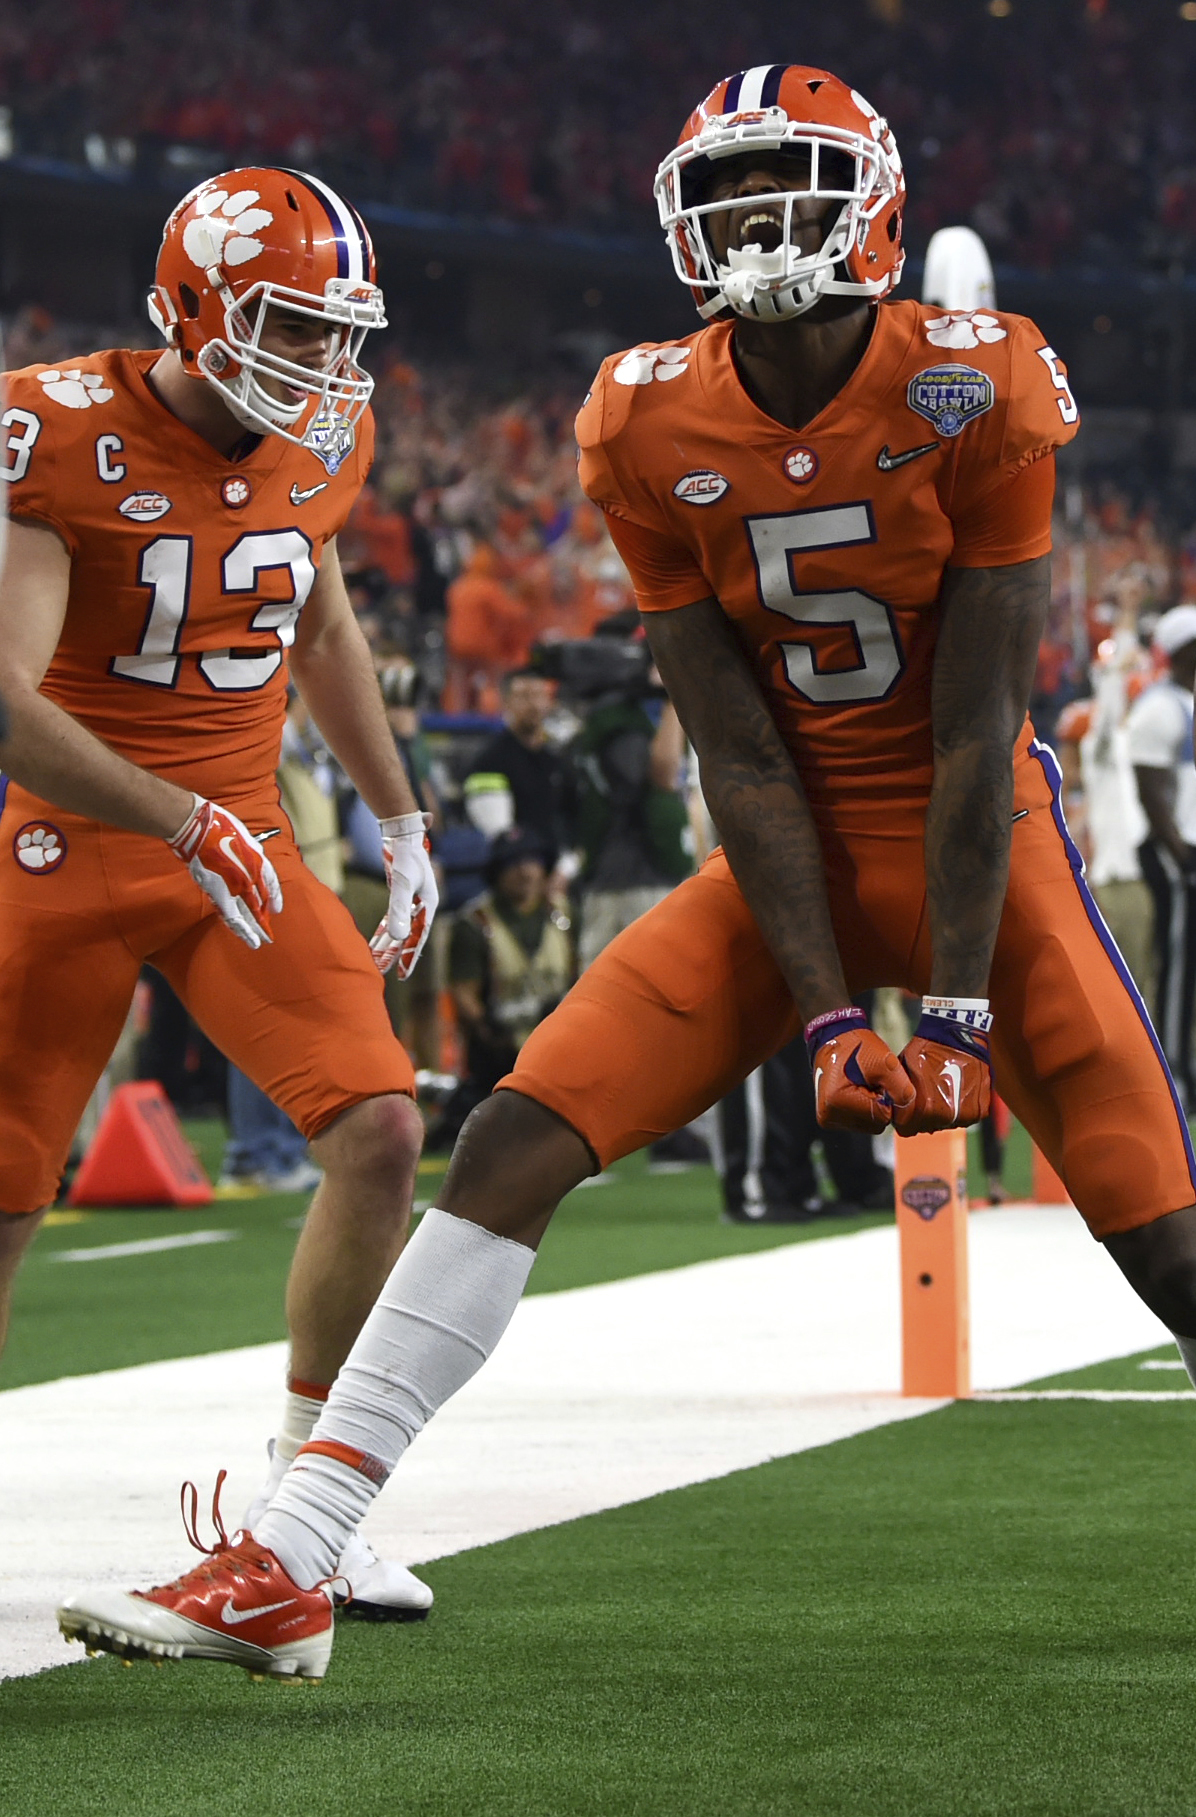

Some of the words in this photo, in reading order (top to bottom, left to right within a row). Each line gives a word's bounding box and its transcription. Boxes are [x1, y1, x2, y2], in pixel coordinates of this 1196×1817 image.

[915, 385, 986, 407] COTTON
[1035, 345, 1078, 424] 5
[927, 397, 973, 411] BOWL
[96, 434, 126, 483] C
[682, 476, 720, 494] ACC
[125, 497, 164, 511] ACC
[108, 526, 317, 692] 13
[743, 499, 906, 705] 5
